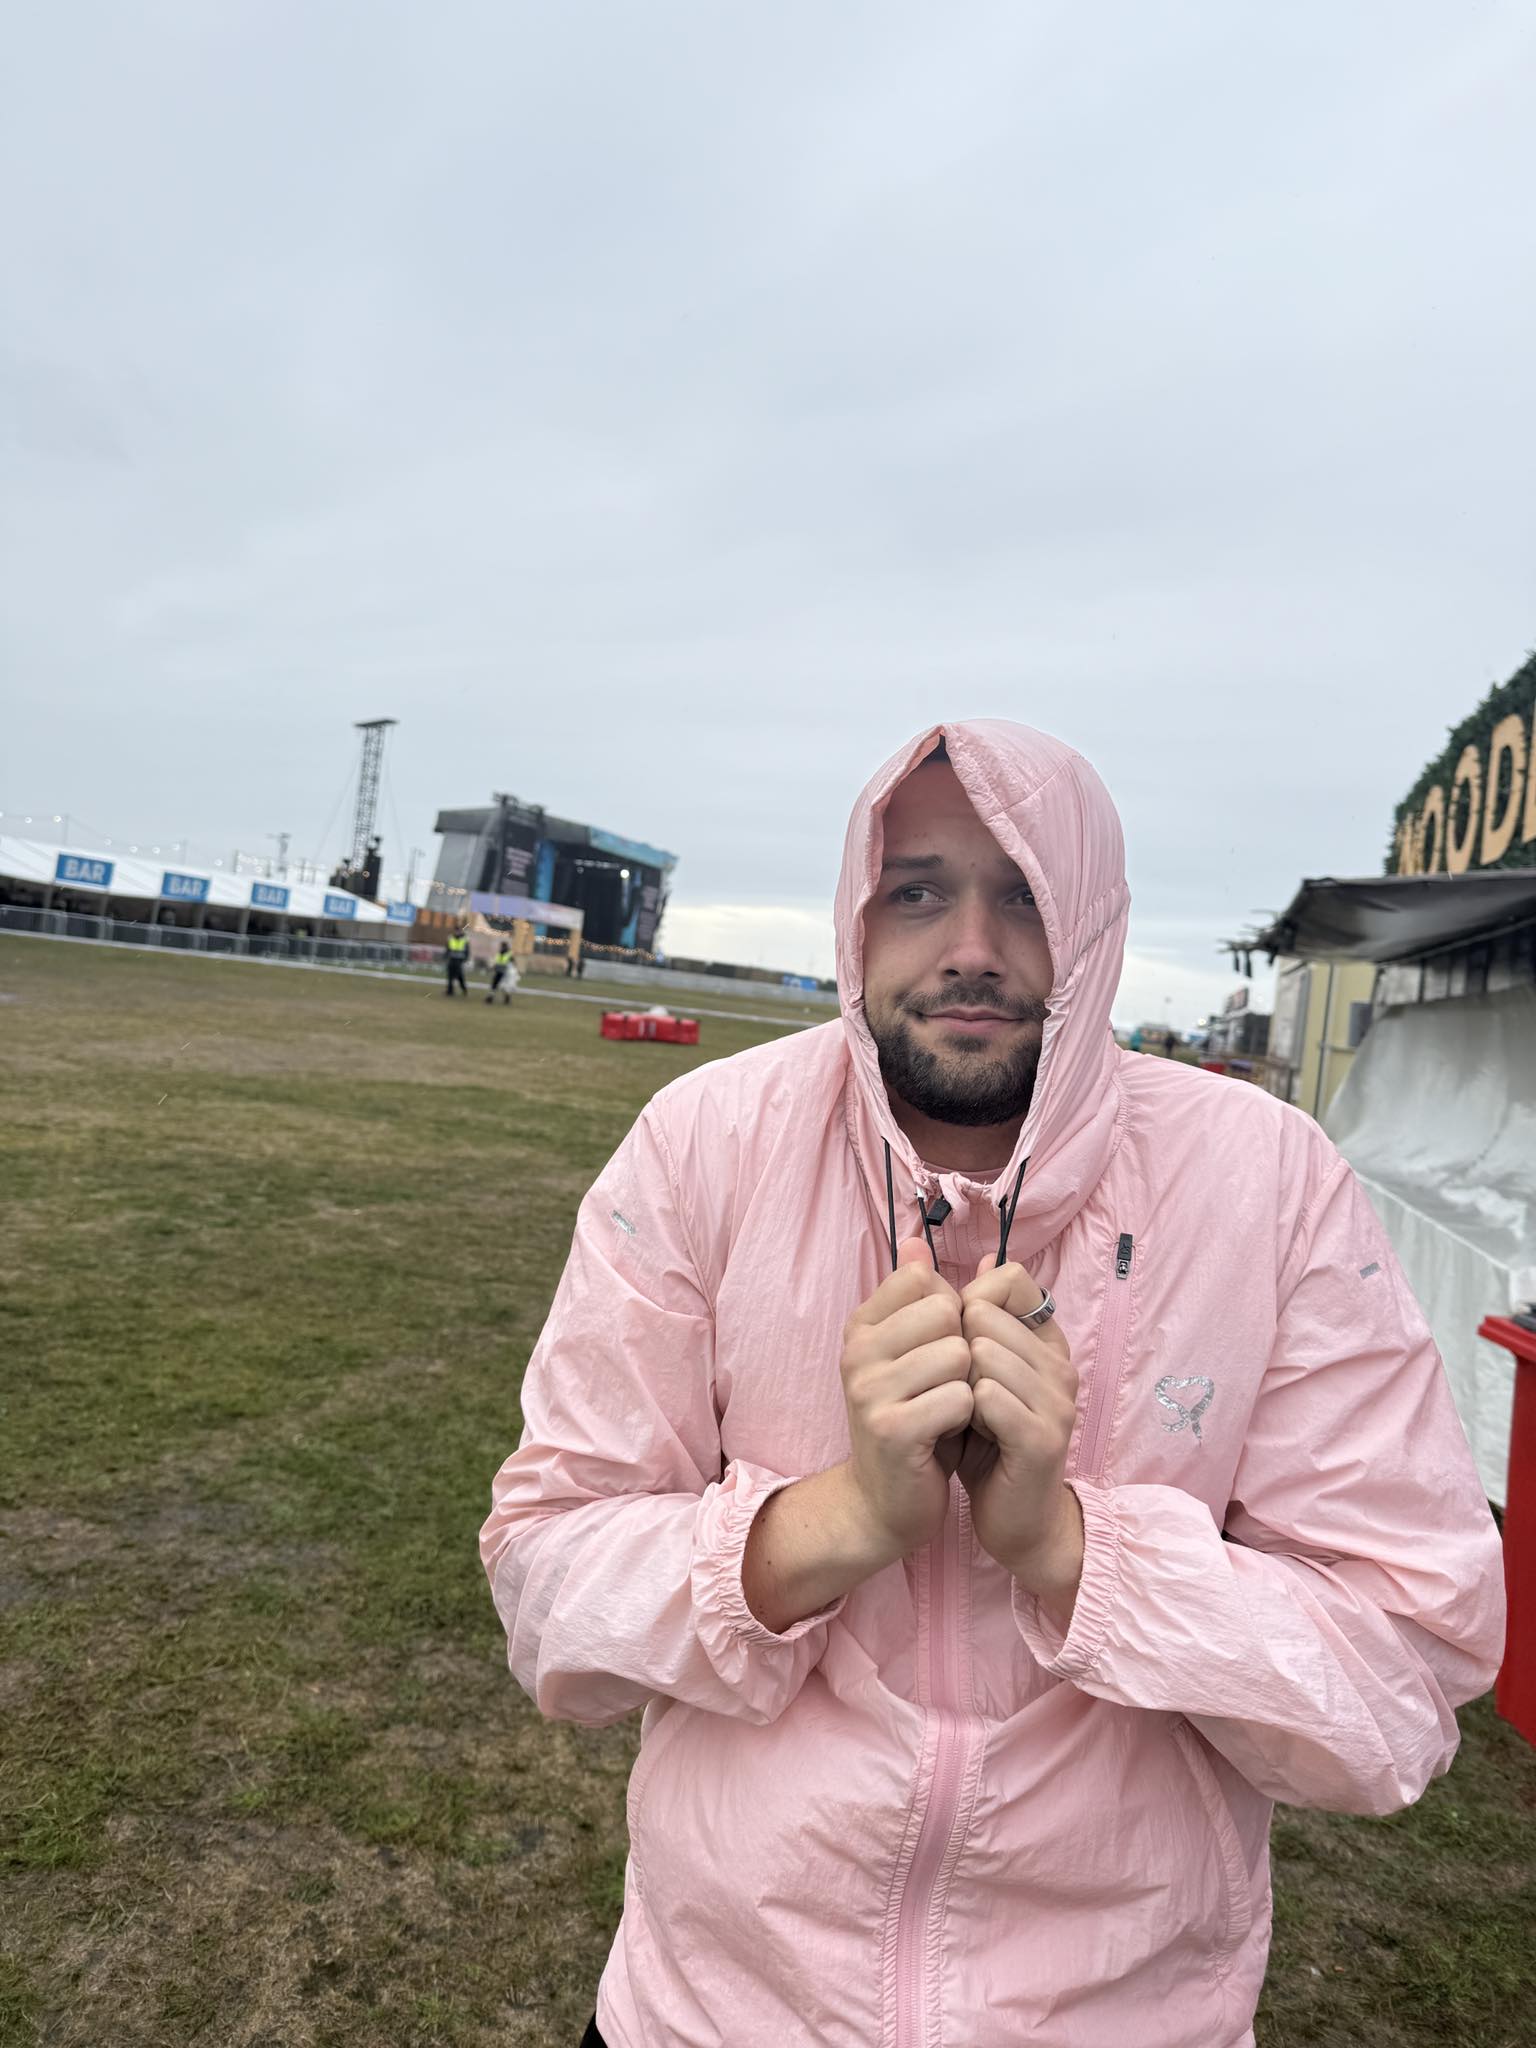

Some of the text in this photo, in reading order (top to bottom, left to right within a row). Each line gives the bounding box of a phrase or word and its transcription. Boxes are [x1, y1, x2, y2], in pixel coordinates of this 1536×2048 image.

[64, 857, 106, 881] BAR
[169, 875, 203, 897] BAR
[256, 885, 286, 906] BAR
